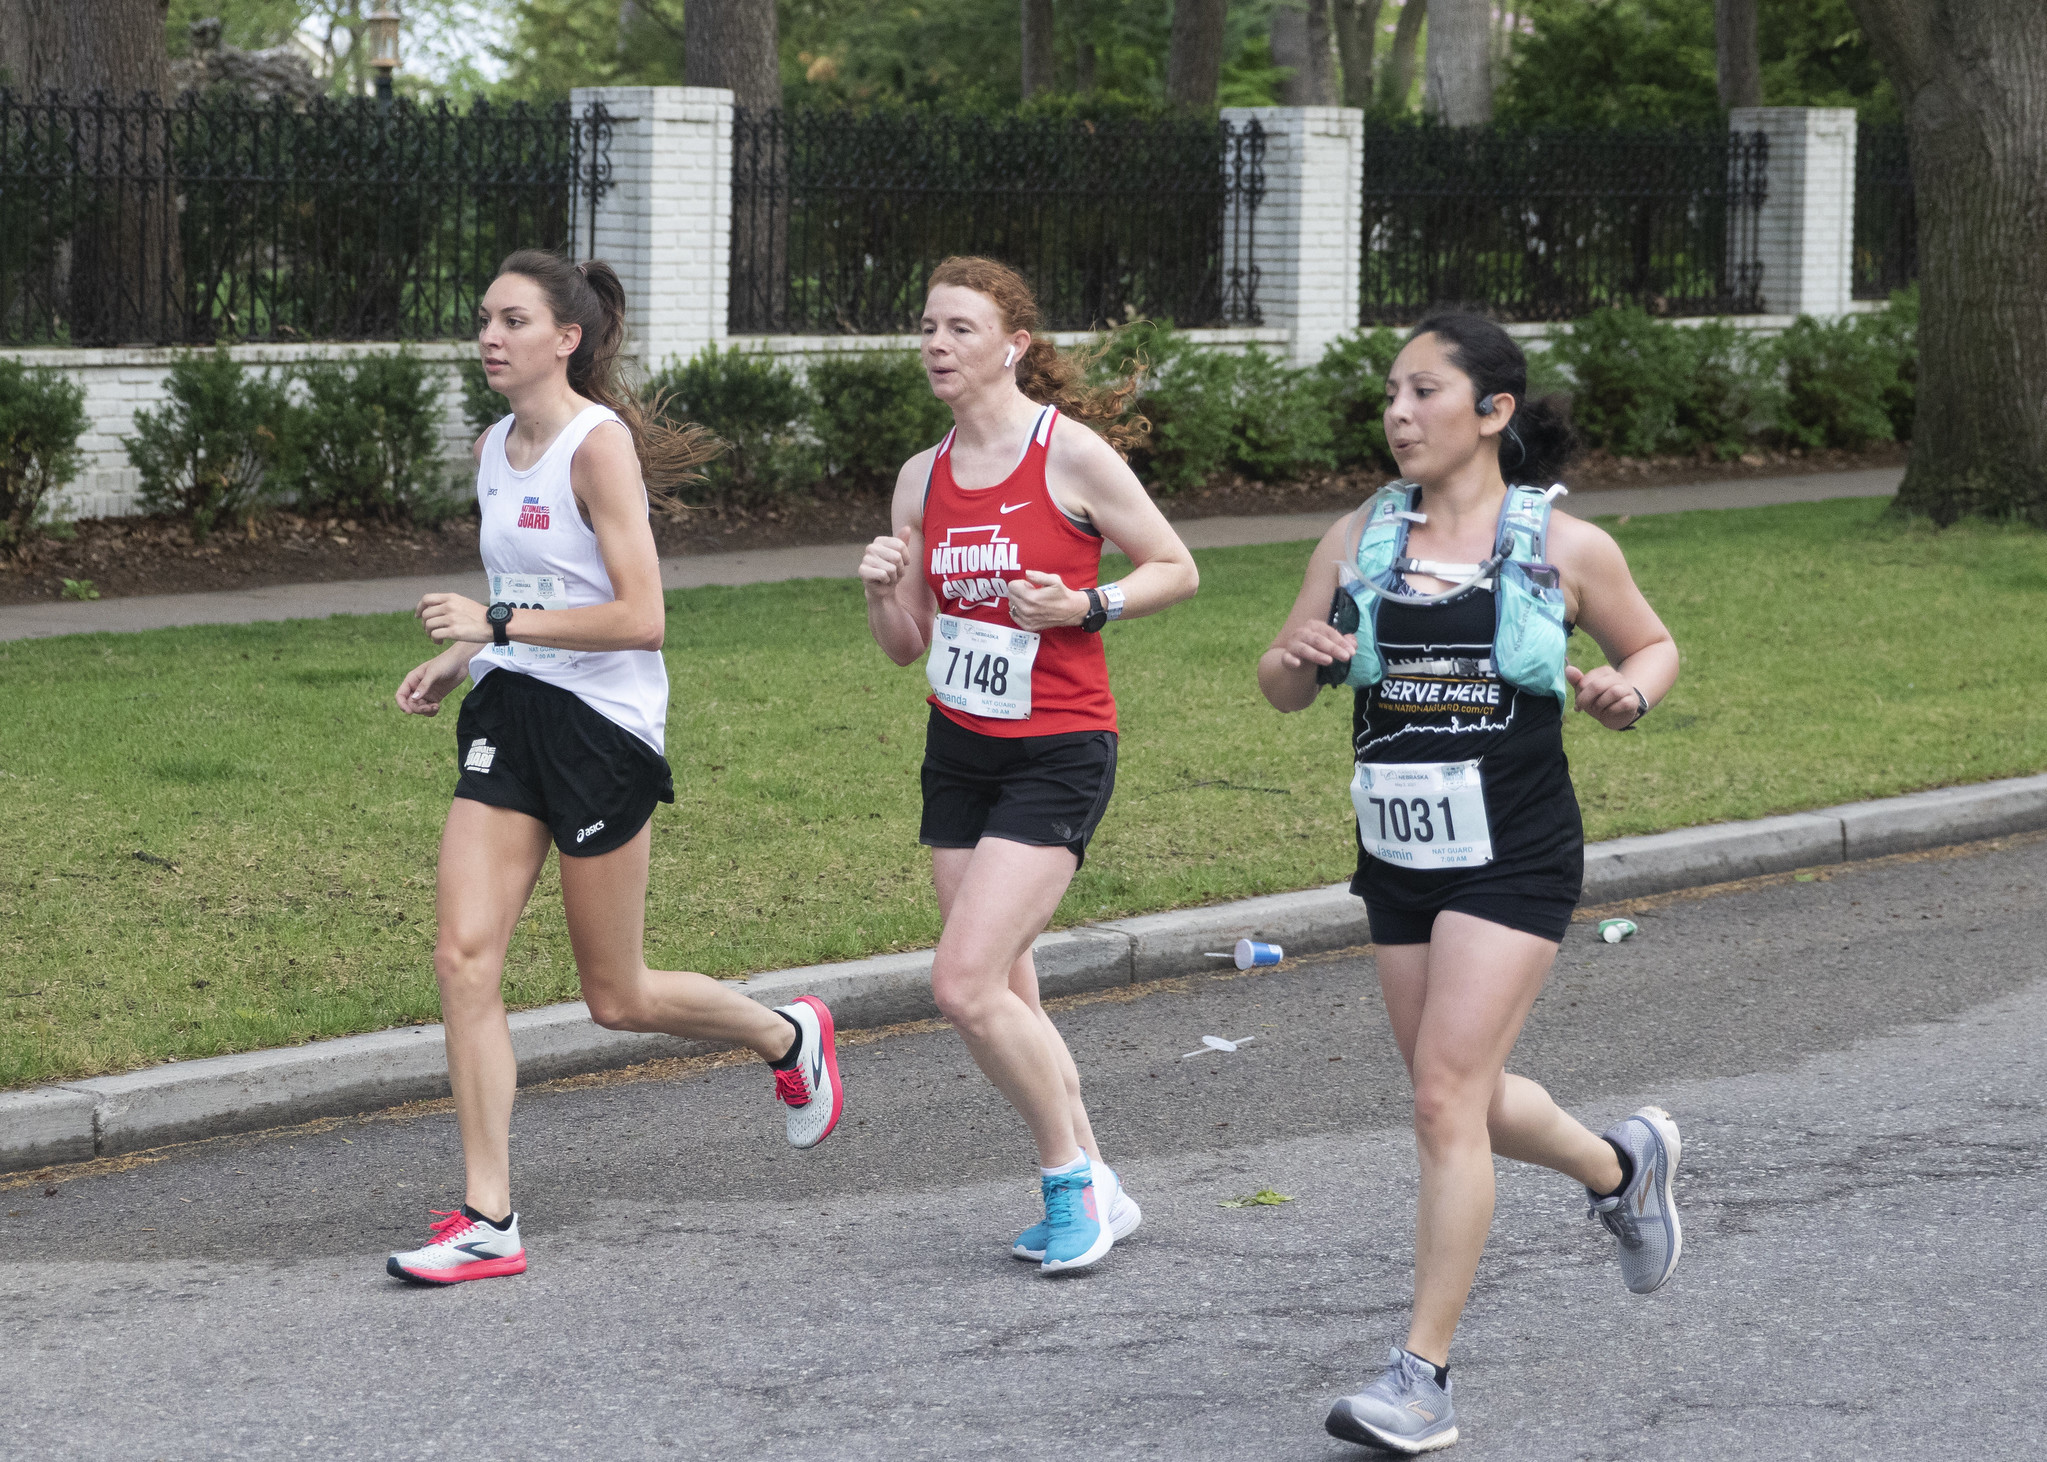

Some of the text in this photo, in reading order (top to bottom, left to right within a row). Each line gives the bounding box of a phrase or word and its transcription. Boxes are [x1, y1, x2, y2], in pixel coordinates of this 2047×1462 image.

[517, 513, 550, 530] GUARD
[931, 543, 1021, 574] NATIONAL
[942, 577, 1009, 602] GUARD
[945, 646, 1009, 696] 7148
[935, 687, 967, 706] Amanda
[1380, 680, 1500, 704] SERVE HERE
[994, 701, 1016, 709] GUARD
[585, 820, 605, 837] asics
[1369, 796, 1456, 843] 7031
[1375, 844, 1413, 860] Jasmin
[1447, 846, 1473, 854] GUARD
